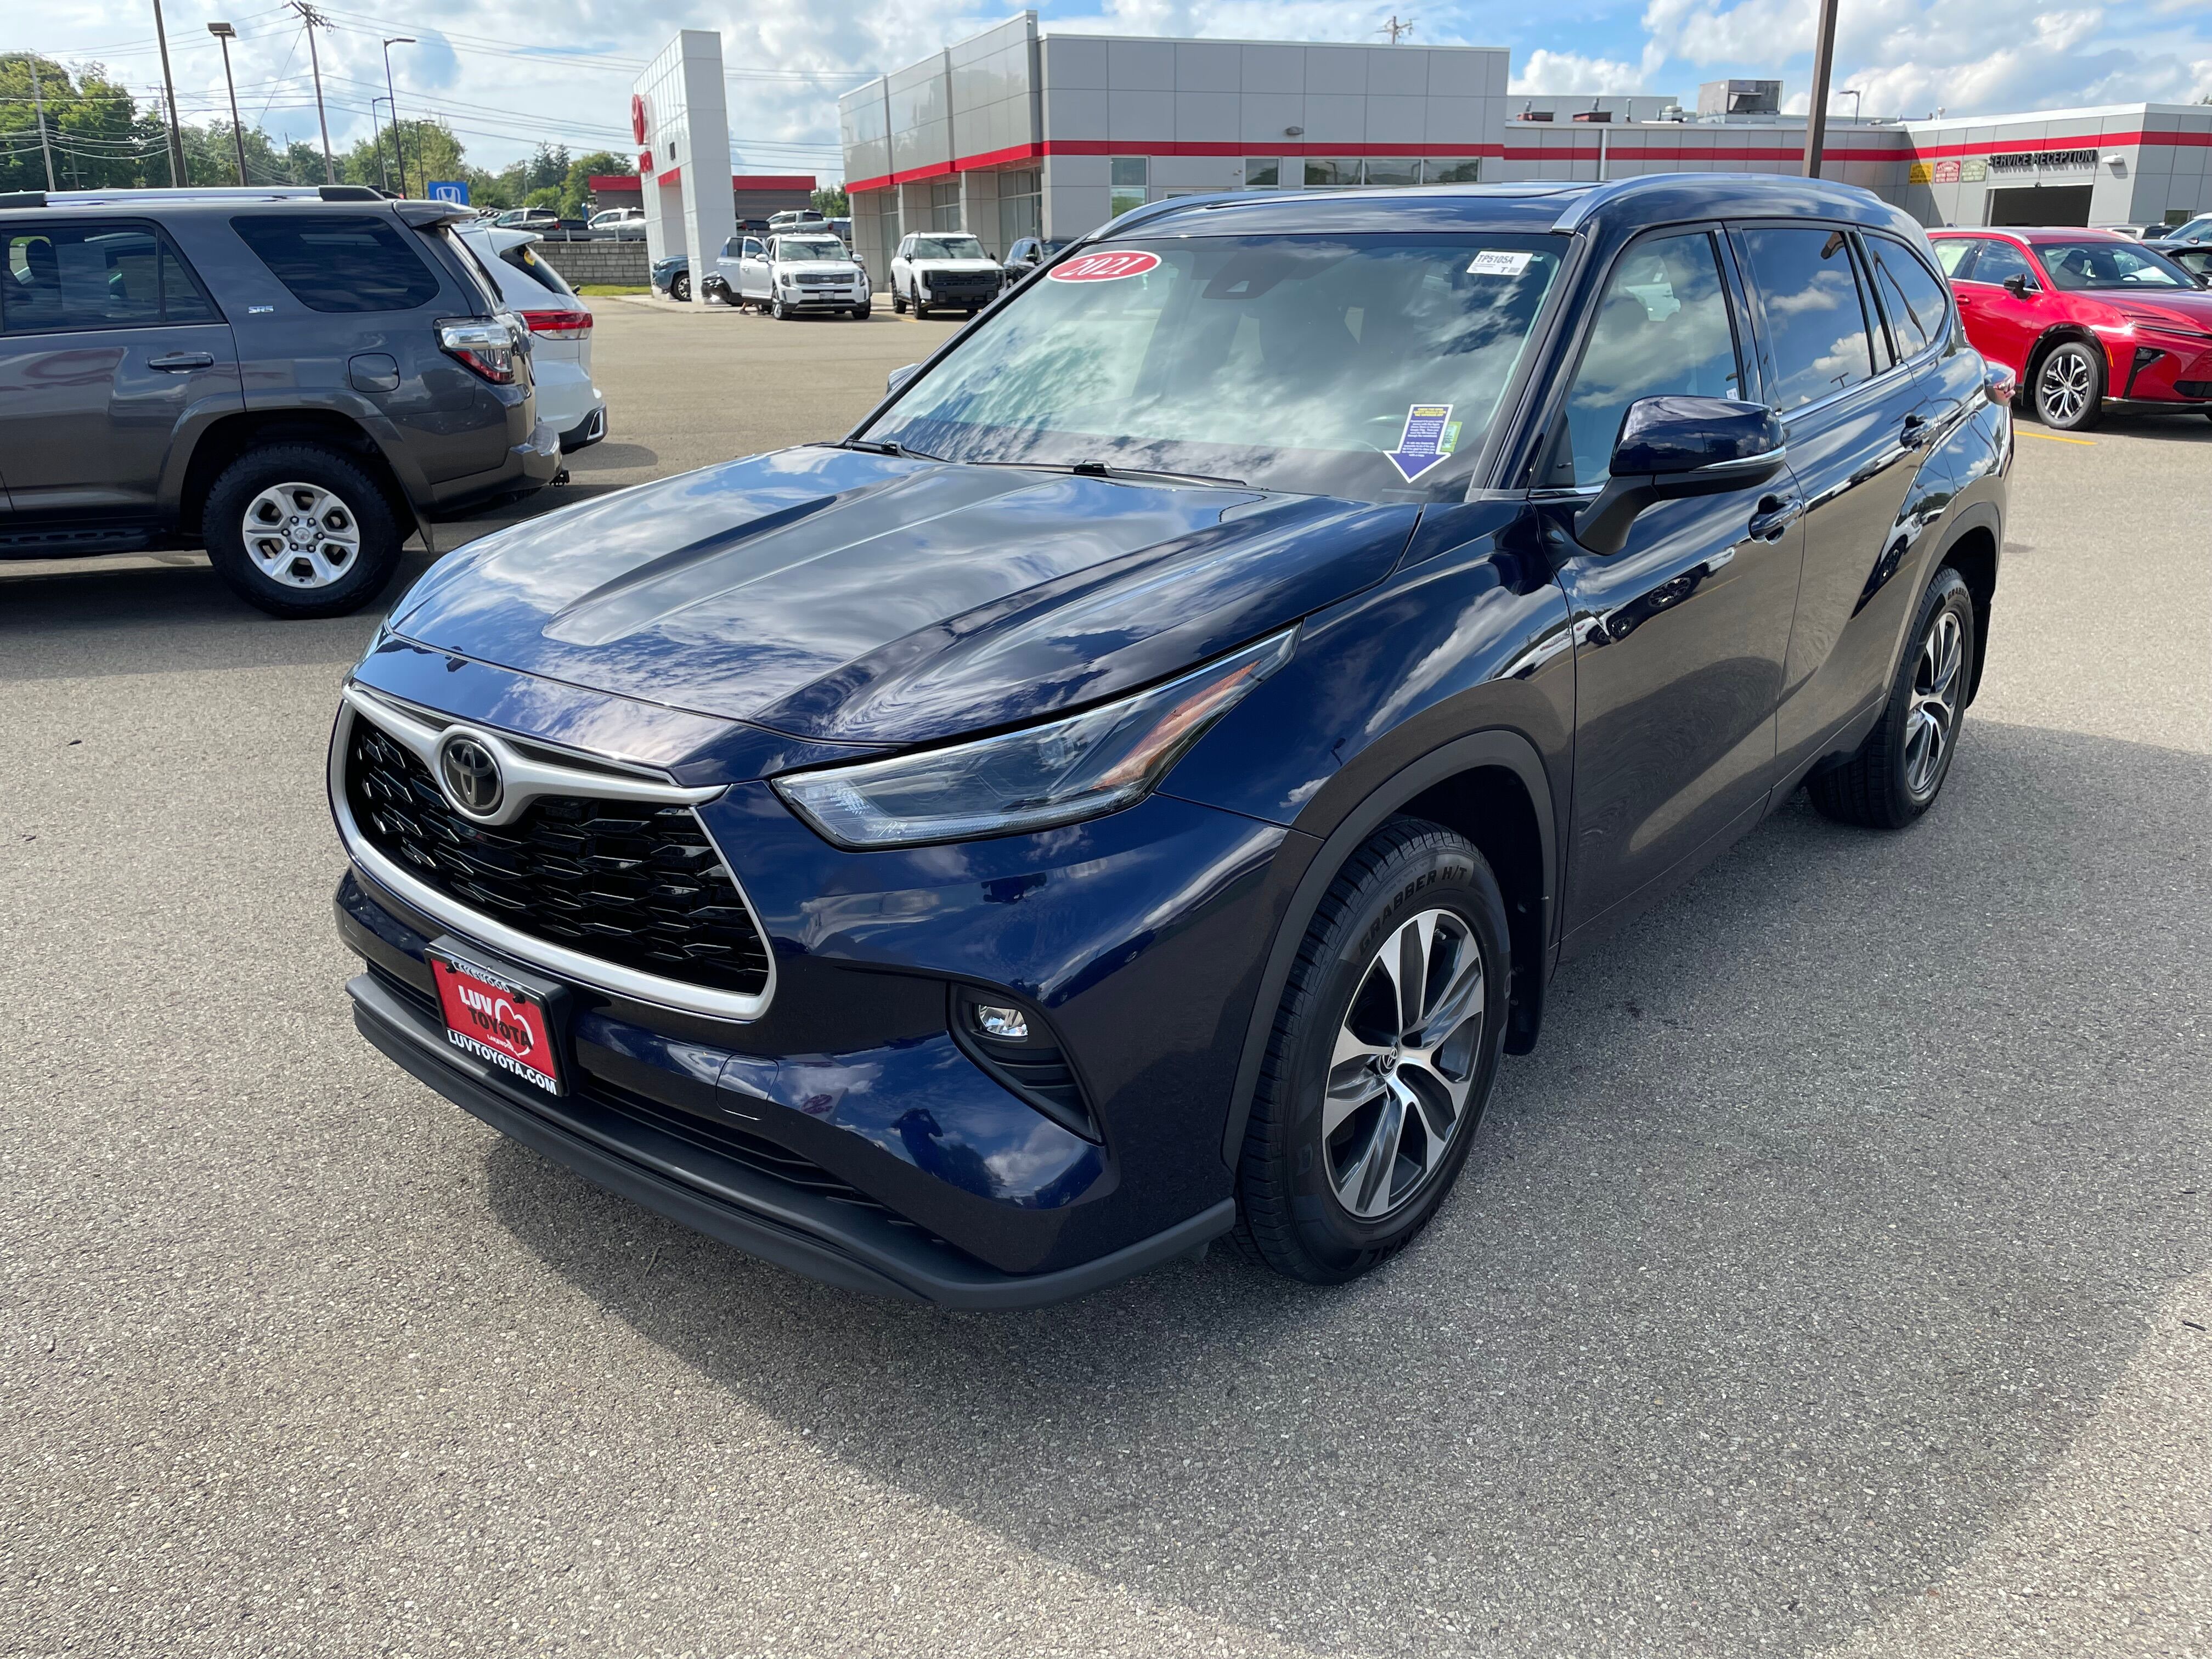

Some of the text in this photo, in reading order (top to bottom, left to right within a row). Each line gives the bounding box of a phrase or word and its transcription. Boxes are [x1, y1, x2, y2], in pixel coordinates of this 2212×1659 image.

[1989, 149, 2097, 167] SERVICE RECEPTION
[1057, 256, 1149, 277] 2021
[1476, 255, 1514, 264] TP5105A
[1359, 869, 1437, 956] GRABBER
[1441, 865, 1467, 881] H/T
[451, 960, 511, 993] LAKEWOOD
[458, 985, 493, 1015] LUV
[467, 1006, 533, 1050] TOYOTA
[447, 1029, 557, 1095] LUVTOYOTA.COM
